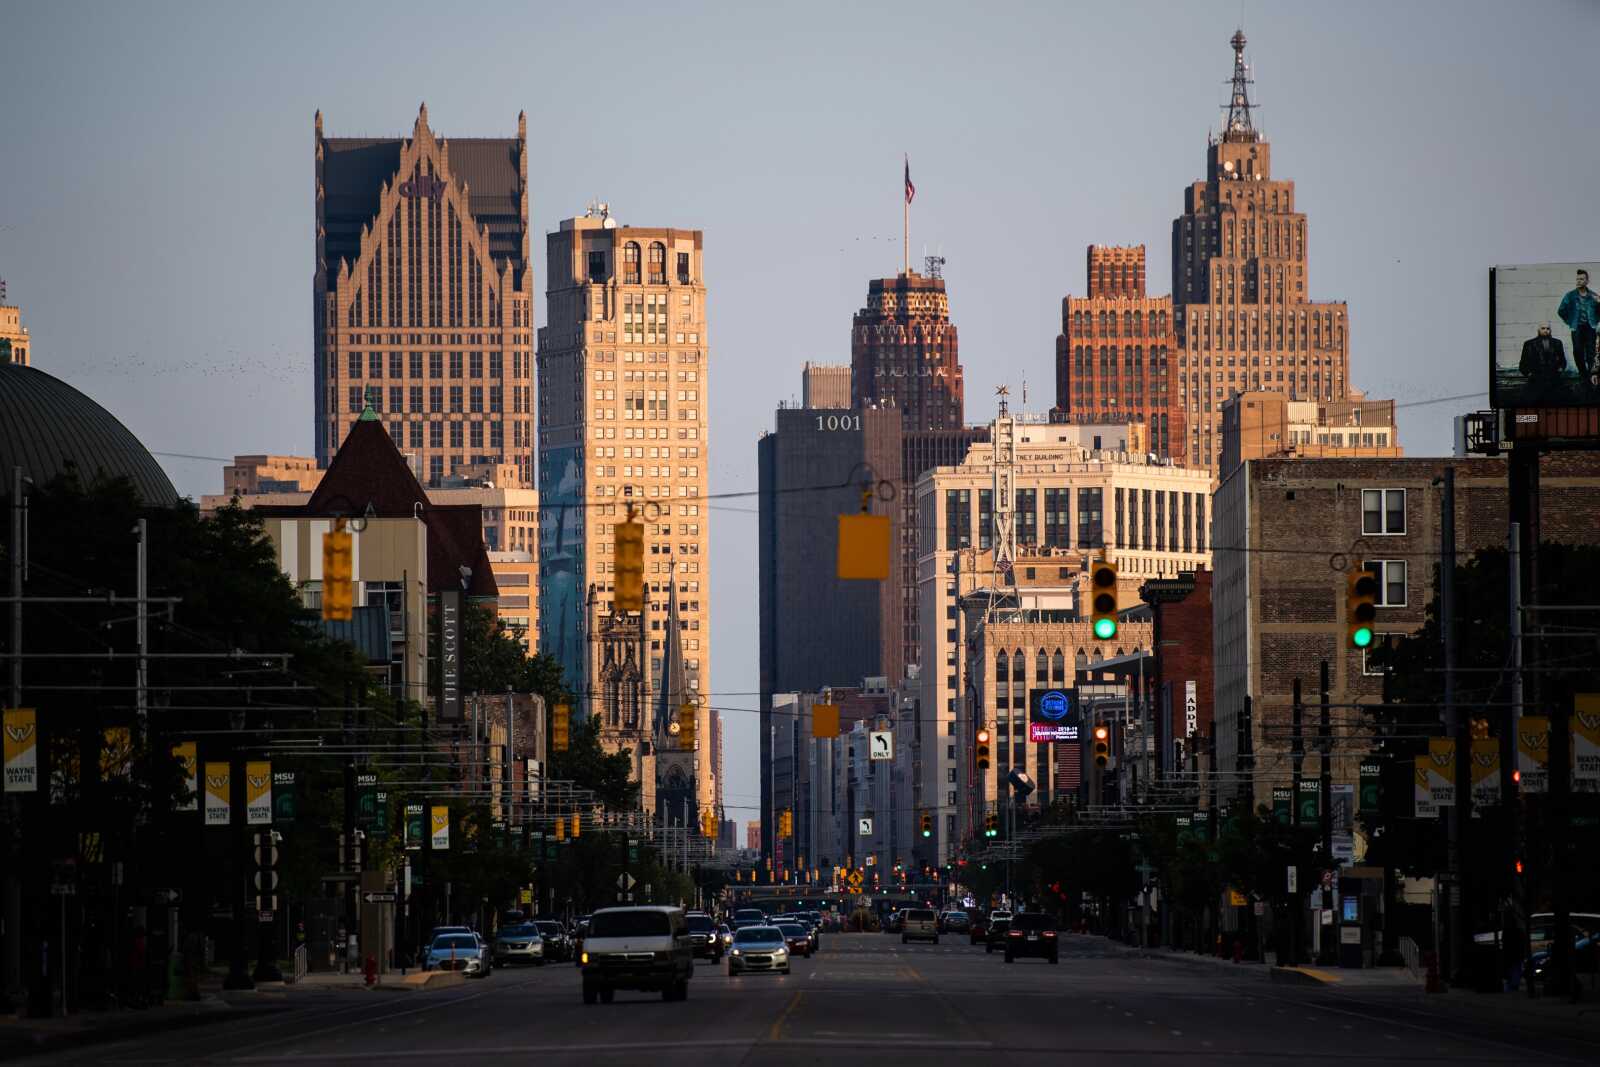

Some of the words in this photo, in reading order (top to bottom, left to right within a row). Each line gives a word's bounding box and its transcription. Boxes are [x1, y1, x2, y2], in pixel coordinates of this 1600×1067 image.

[816, 415, 861, 431] 1001
[1034, 453, 1064, 461] BUILDING
[445, 604, 456, 662] SCOTT
[445, 668, 456, 704] THE
[6, 767, 35, 775] WAYNE
[9, 775, 33, 783] STATE
[274, 772, 295, 780] MSU
[357, 775, 376, 783] MSU
[1523, 779, 1544, 787] STATE
